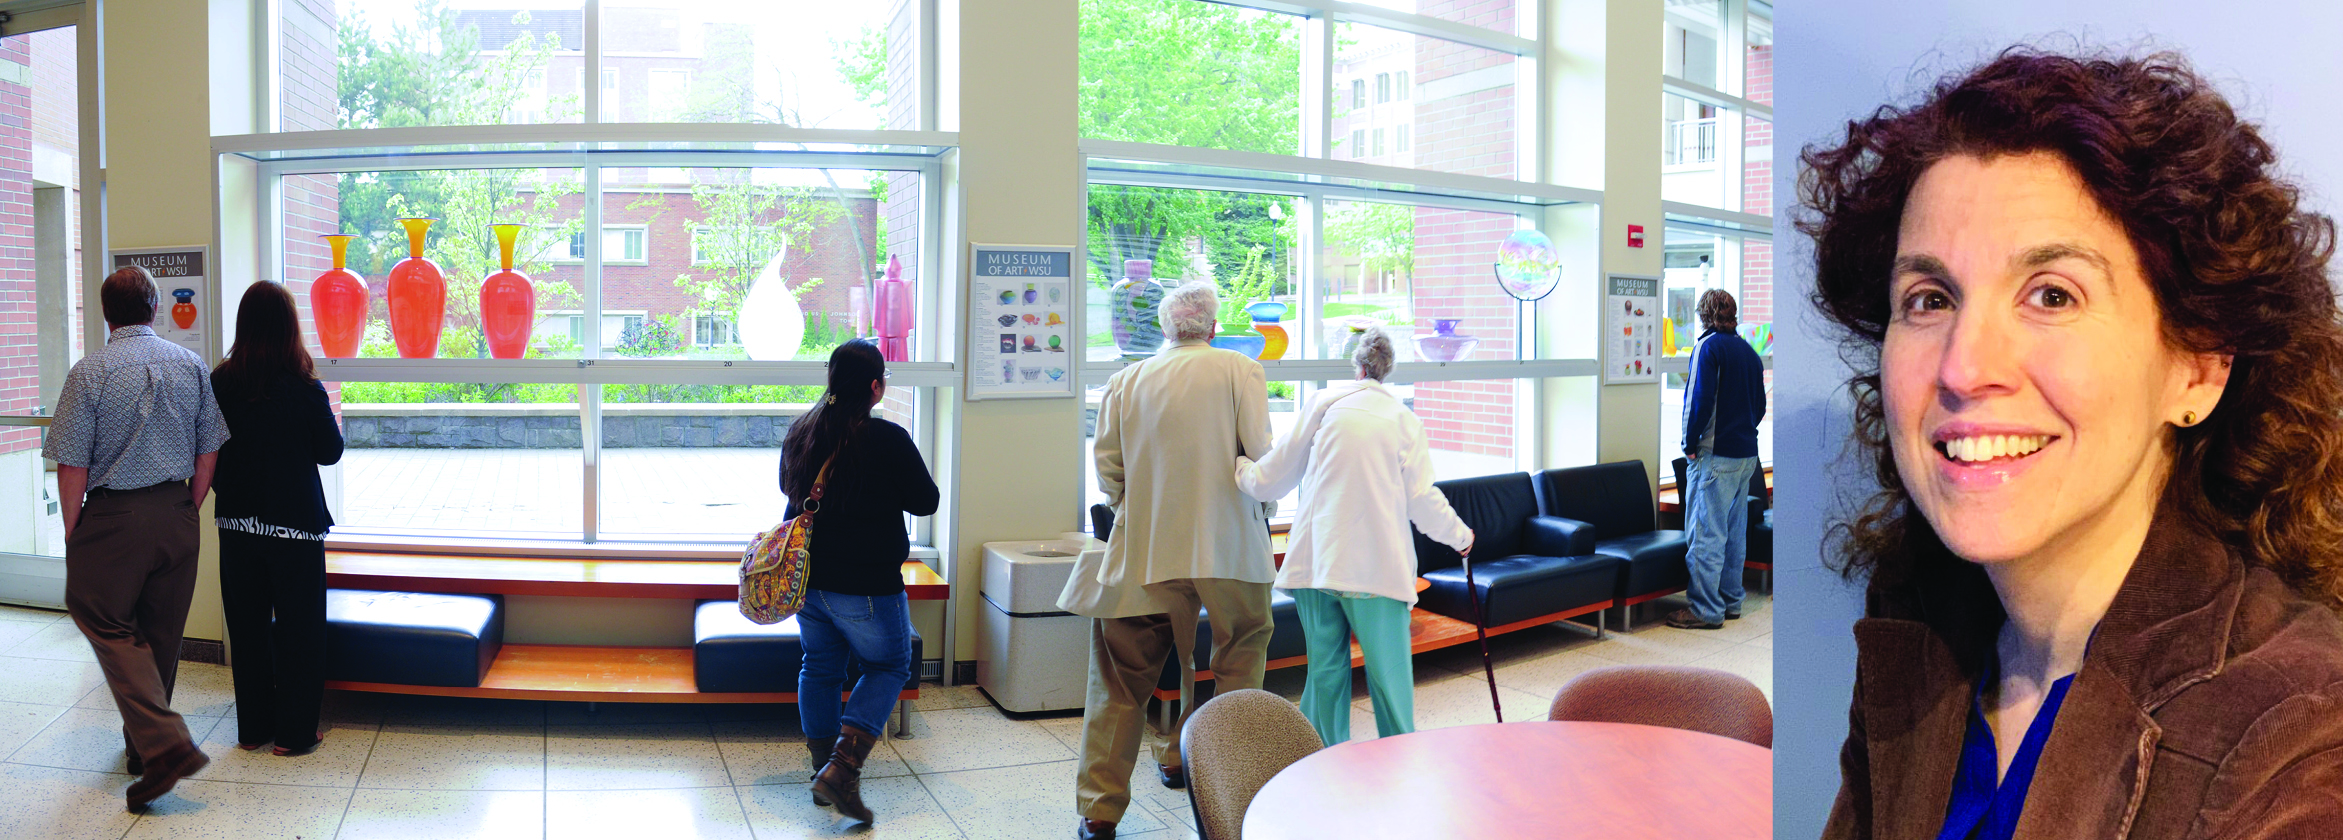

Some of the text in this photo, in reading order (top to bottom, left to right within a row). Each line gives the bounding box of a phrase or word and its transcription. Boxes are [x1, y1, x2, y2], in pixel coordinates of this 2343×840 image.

[131, 255, 187, 266] MUSEUM
[988, 254, 1051, 264] MUSEUM
[166, 266, 188, 276] WSU
[988, 266, 1052, 275] OF ART WSU
[1616, 279, 1649, 288] MUSEUM
